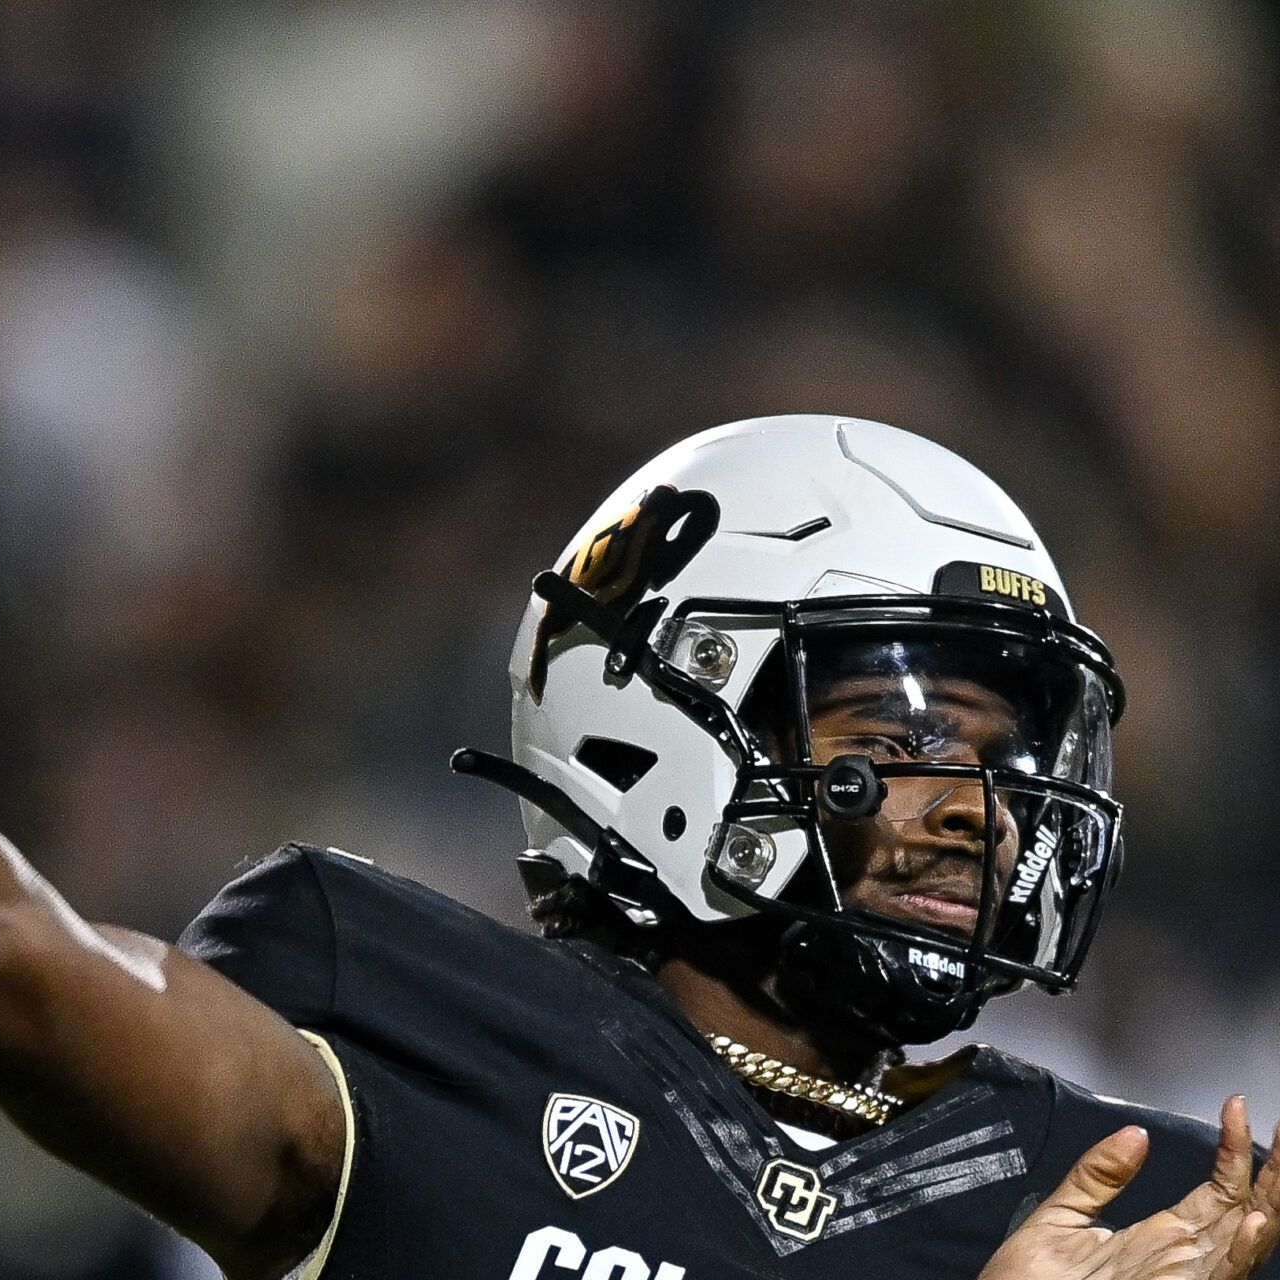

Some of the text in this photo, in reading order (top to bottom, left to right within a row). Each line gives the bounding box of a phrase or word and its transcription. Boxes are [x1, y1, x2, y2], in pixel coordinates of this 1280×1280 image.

[980, 565, 1046, 606] BUFFS
[549, 1098, 635, 1172] PAC
[559, 1141, 606, 1183] 12
